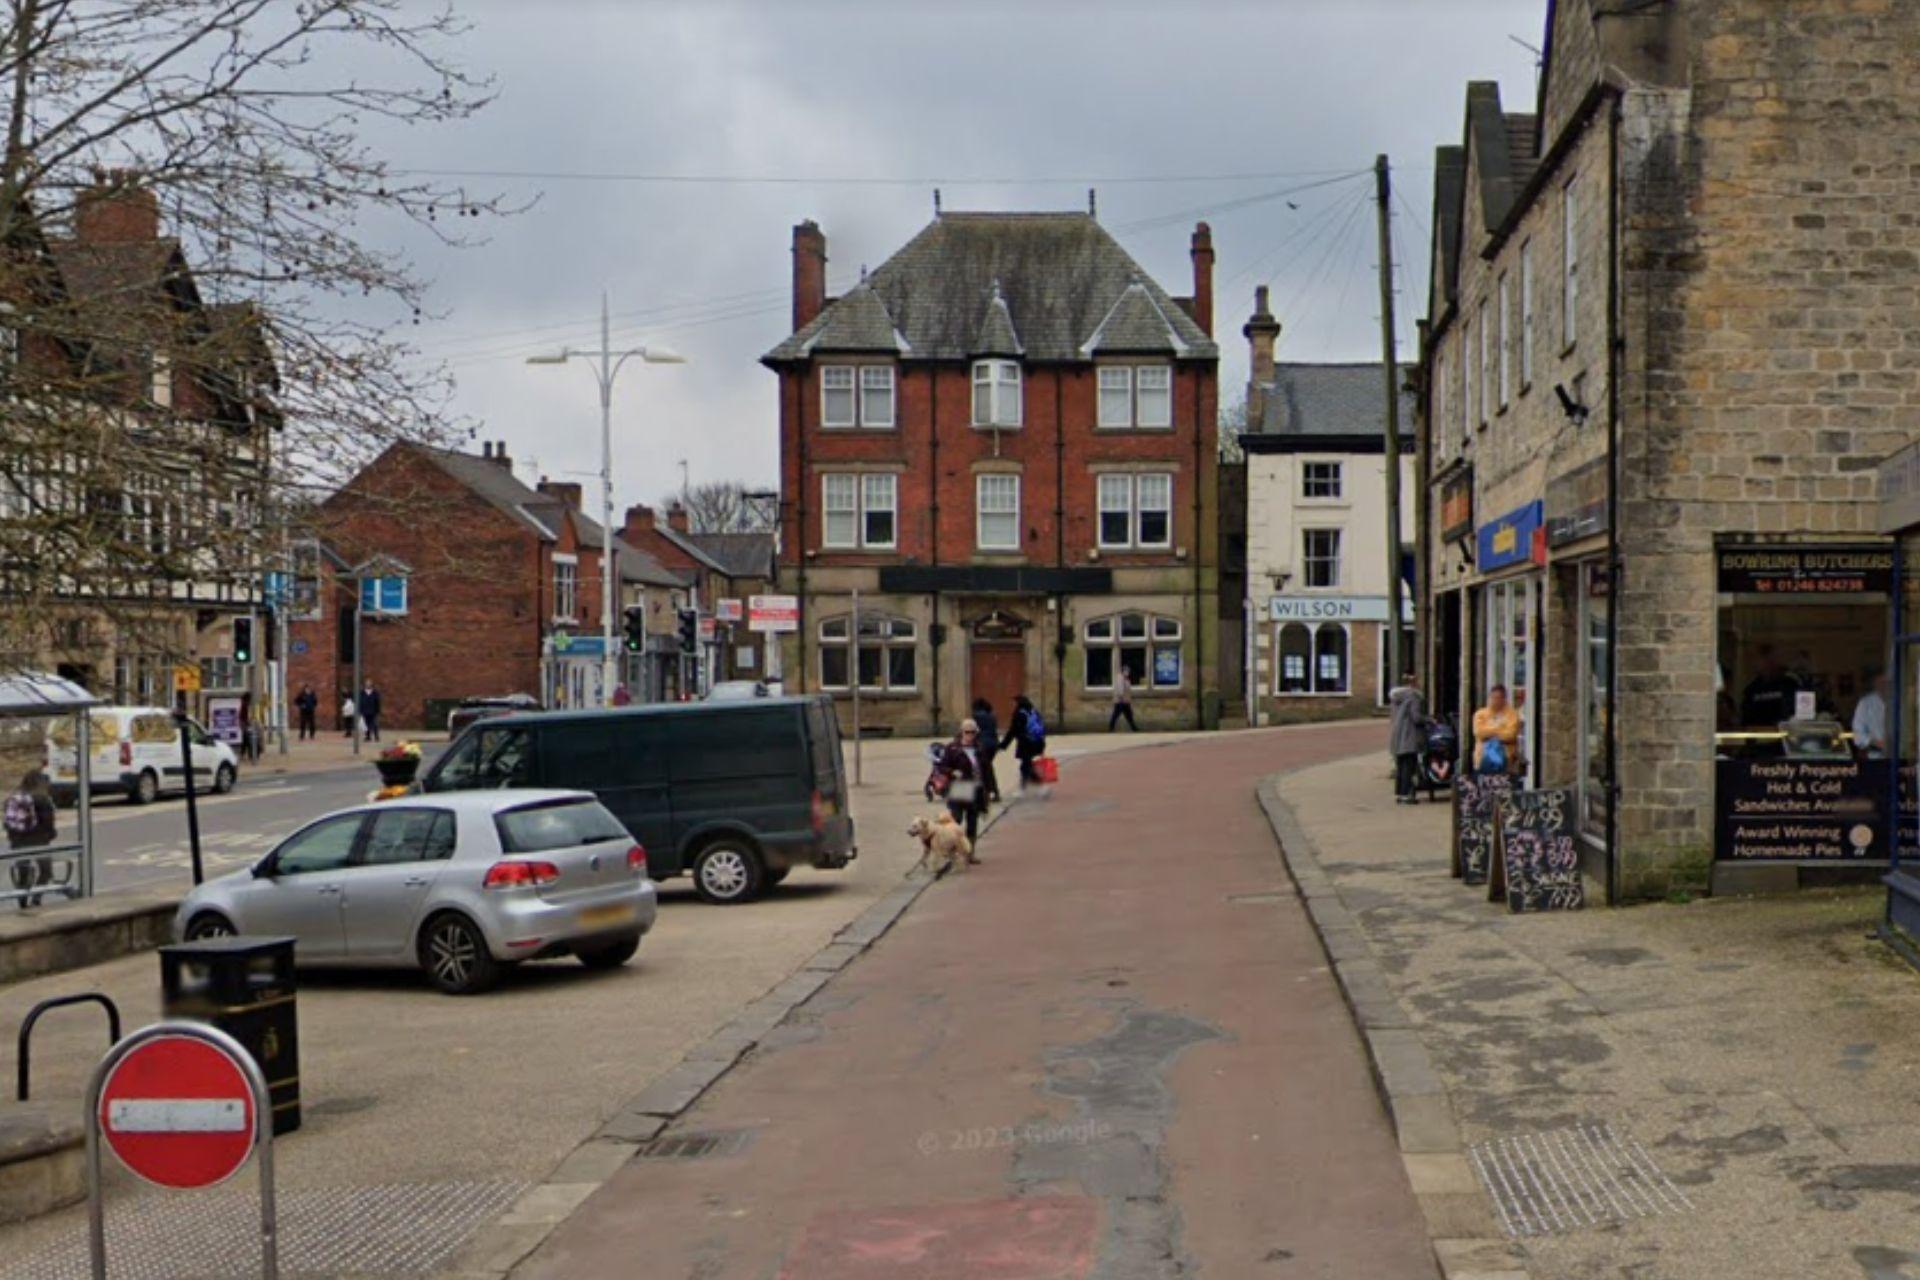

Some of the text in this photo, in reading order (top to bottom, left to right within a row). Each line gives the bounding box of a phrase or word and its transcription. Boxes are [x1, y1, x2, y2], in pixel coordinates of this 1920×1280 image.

[1722, 553, 1800, 568] BOWRING
[1804, 553, 1893, 568] BUTCHERS
[1275, 601, 1352, 617] WILSON
[1750, 764, 1858, 779] Freshly Prepared
[1766, 781, 1842, 794] Hot & Cold
[1734, 799, 1810, 813] Sandwiches
[1736, 826, 1842, 841] Award Winning
[1734, 845, 1842, 857] Homemade Pies
